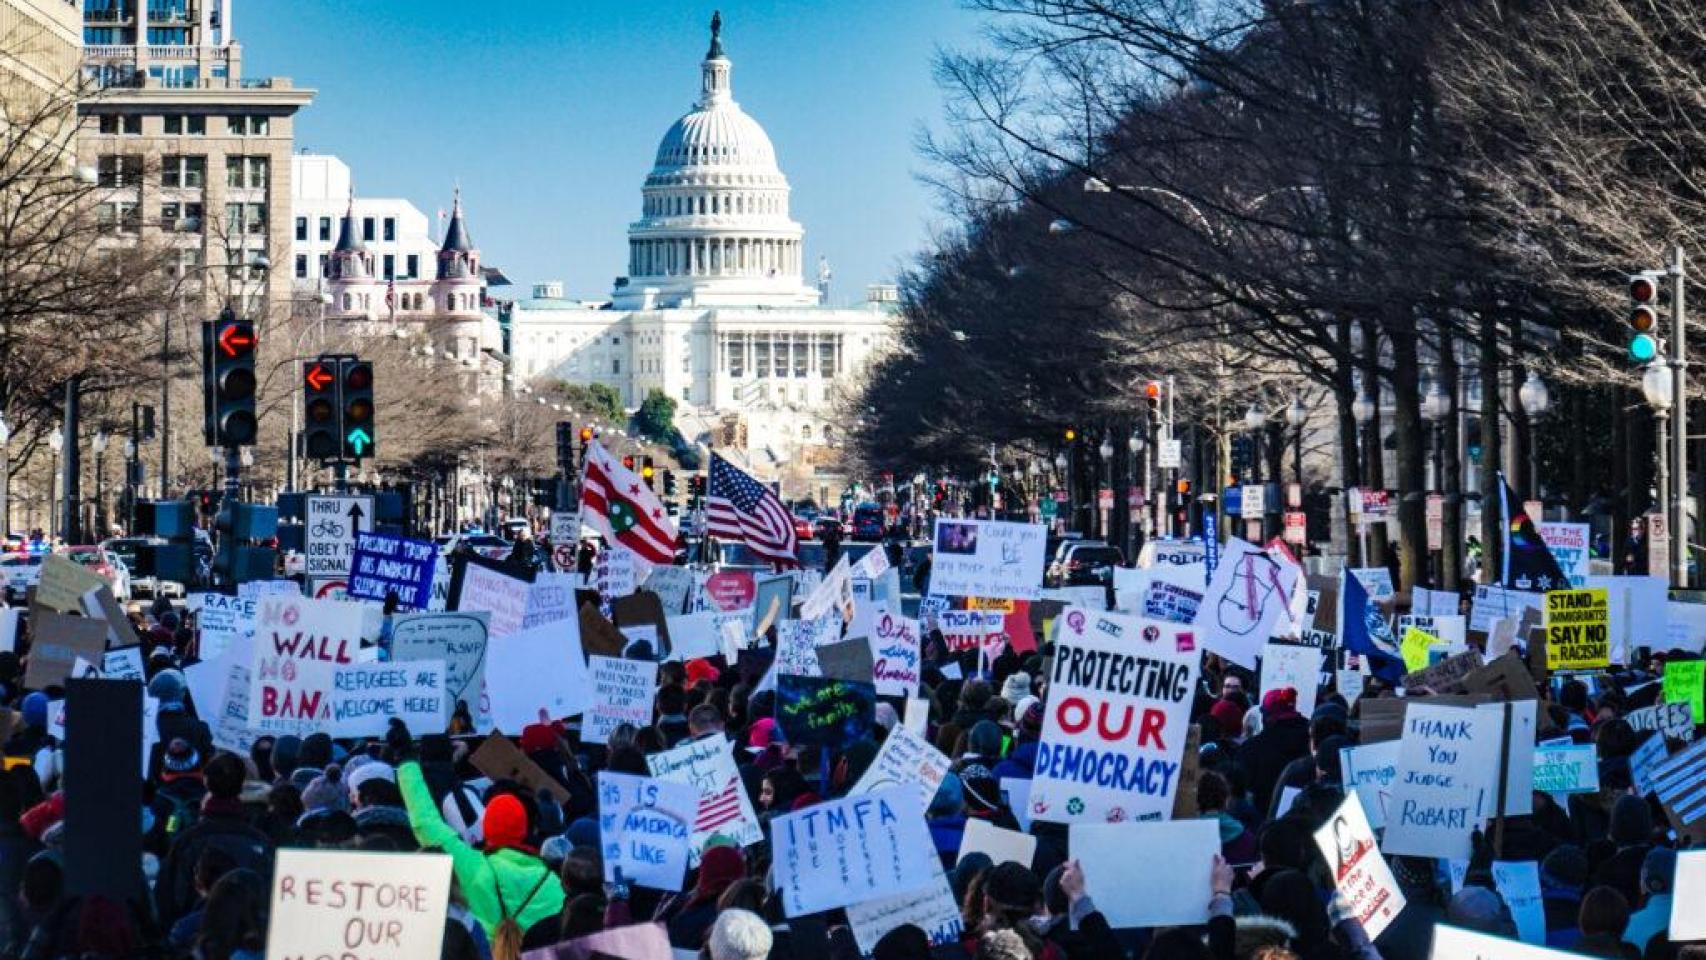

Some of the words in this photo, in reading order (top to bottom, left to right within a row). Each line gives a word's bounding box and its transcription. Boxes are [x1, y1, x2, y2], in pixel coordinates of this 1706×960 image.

[311, 501, 340, 514] THRU
[309, 543, 338, 556] OBEY
[309, 559, 347, 571] SIGNAL
[204, 594, 257, 616] RAGE
[1550, 593, 1592, 609] STAND
[263, 602, 299, 626] NO
[1550, 625, 1581, 644] SAY
[1585, 625, 1607, 642] NO
[272, 631, 352, 664] WALL
[258, 658, 297, 683] NO
[606, 659, 638, 672] WHEN
[335, 670, 407, 691] REFUGEES
[415, 671, 438, 689] ARE
[262, 686, 322, 720] BAN
[334, 698, 396, 722] WELCOME
[404, 696, 439, 714] HERE!
[1056, 697, 1167, 751] OUR
[1410, 718, 1473, 740] THANK
[1036, 741, 1178, 797] DEMOCRACY
[1403, 771, 1454, 787] JUDGE
[636, 781, 660, 807] IS
[623, 813, 689, 839] AMERICA
[632, 840, 667, 864] LIKE
[280, 875, 429, 913] RESTORE
[344, 917, 403, 949] OUR
